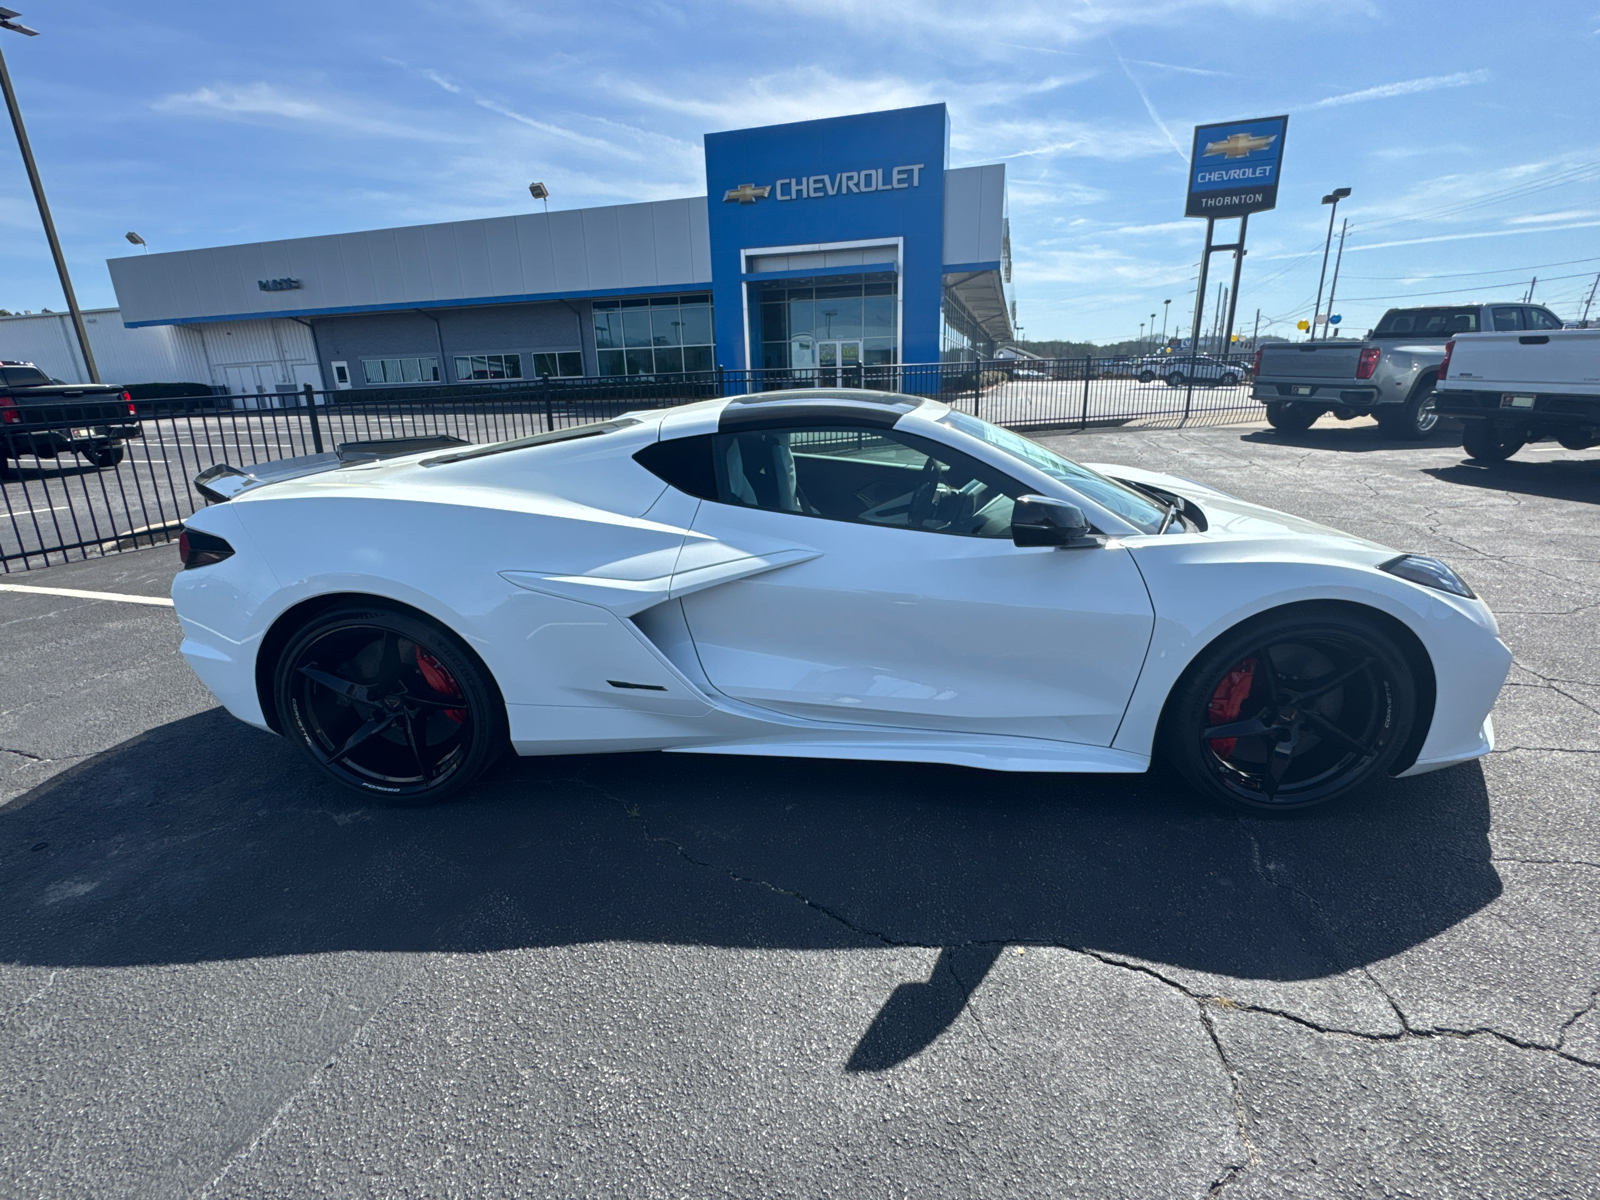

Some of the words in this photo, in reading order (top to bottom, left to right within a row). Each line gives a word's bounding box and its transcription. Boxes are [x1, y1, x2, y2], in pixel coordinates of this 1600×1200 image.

[776, 164, 924, 201] CHEVROLET
[1198, 166, 1272, 183] CHEVROLET
[1201, 193, 1263, 208] THORNTON
